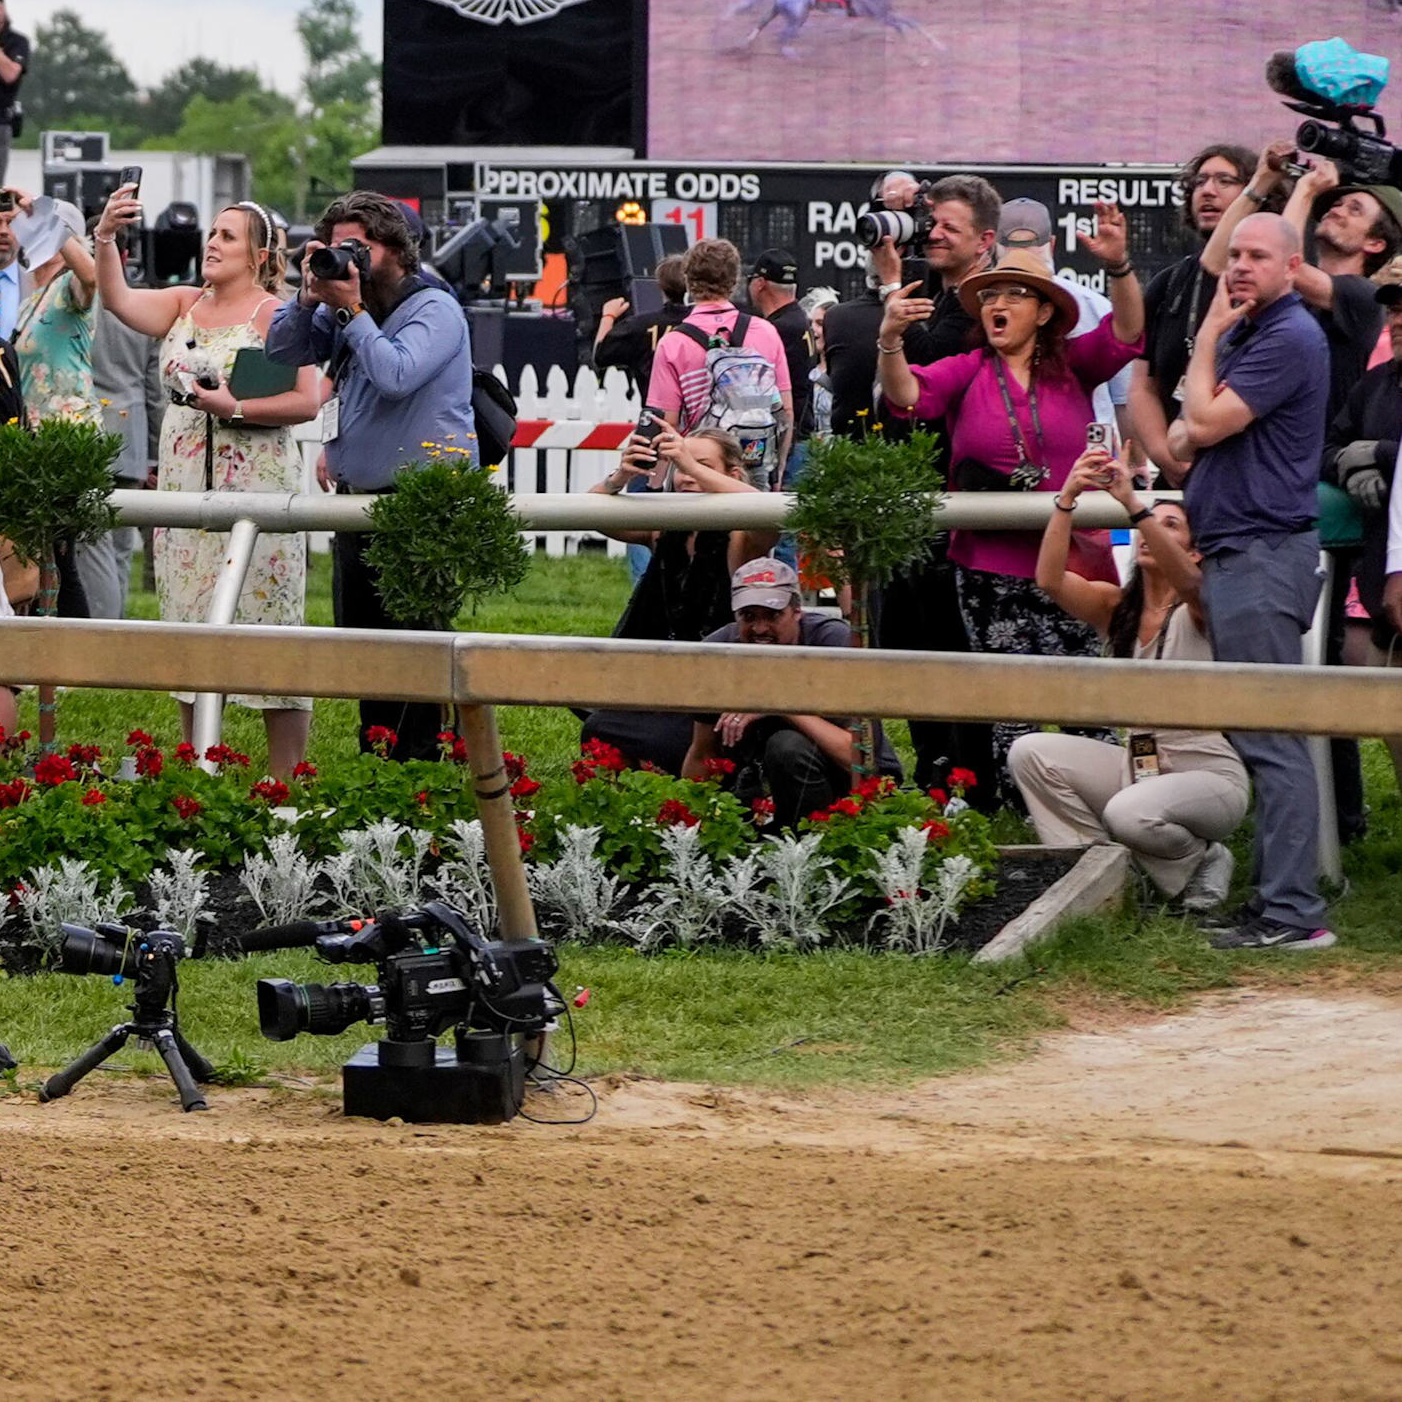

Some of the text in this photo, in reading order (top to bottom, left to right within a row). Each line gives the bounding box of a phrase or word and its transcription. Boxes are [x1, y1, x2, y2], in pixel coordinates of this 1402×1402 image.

[487, 171, 761, 200] PPROXIMATE ODDS
[1058, 178, 1188, 207] RESULTS
